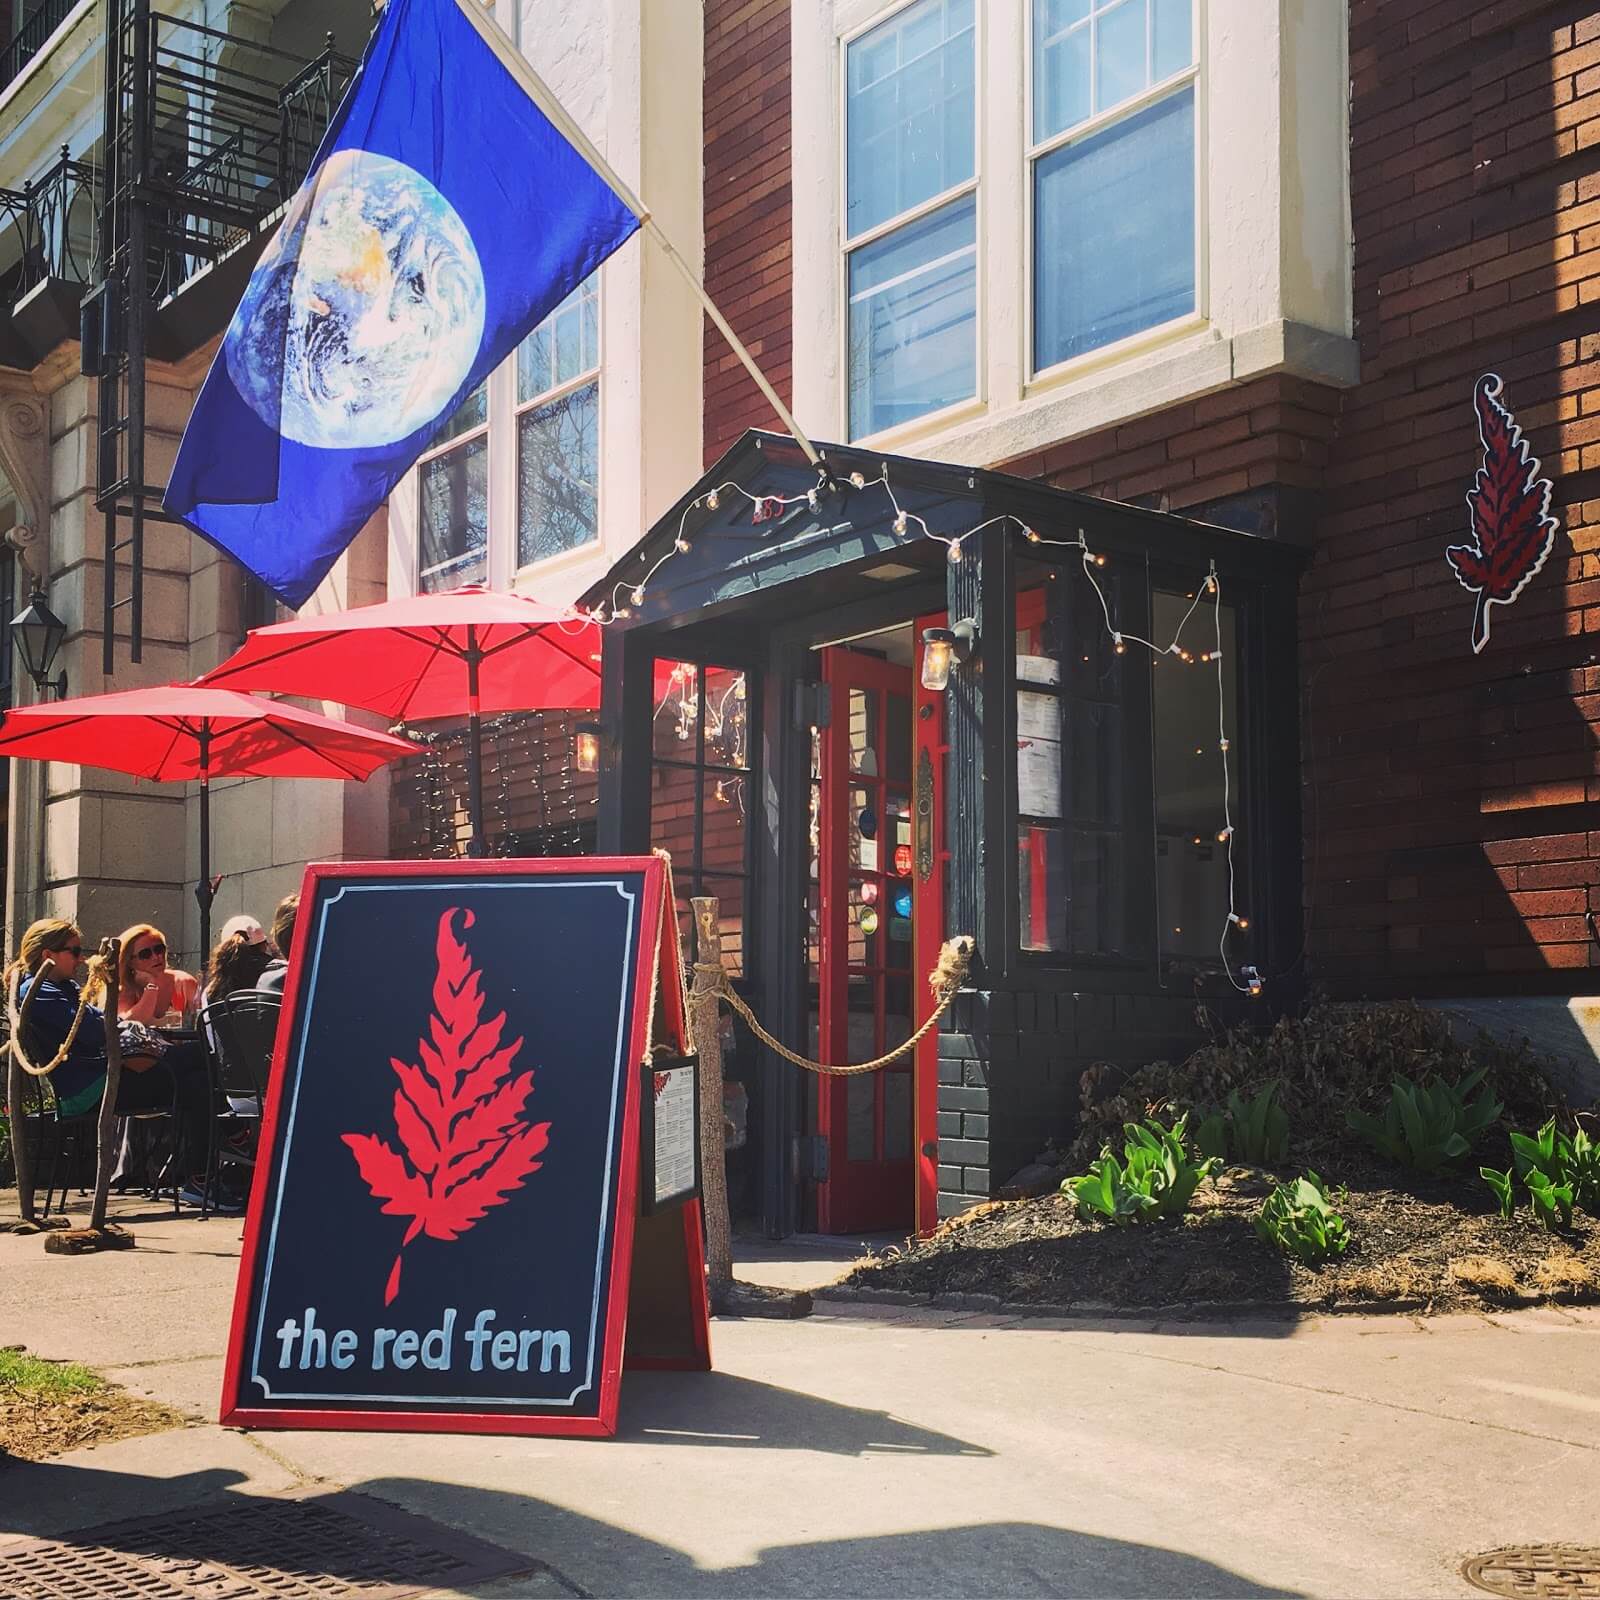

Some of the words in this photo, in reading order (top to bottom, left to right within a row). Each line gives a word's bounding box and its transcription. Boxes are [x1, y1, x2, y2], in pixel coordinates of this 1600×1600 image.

[276, 1307, 358, 1370] the
[371, 1308, 457, 1371] red
[464, 1309, 571, 1373] fern
